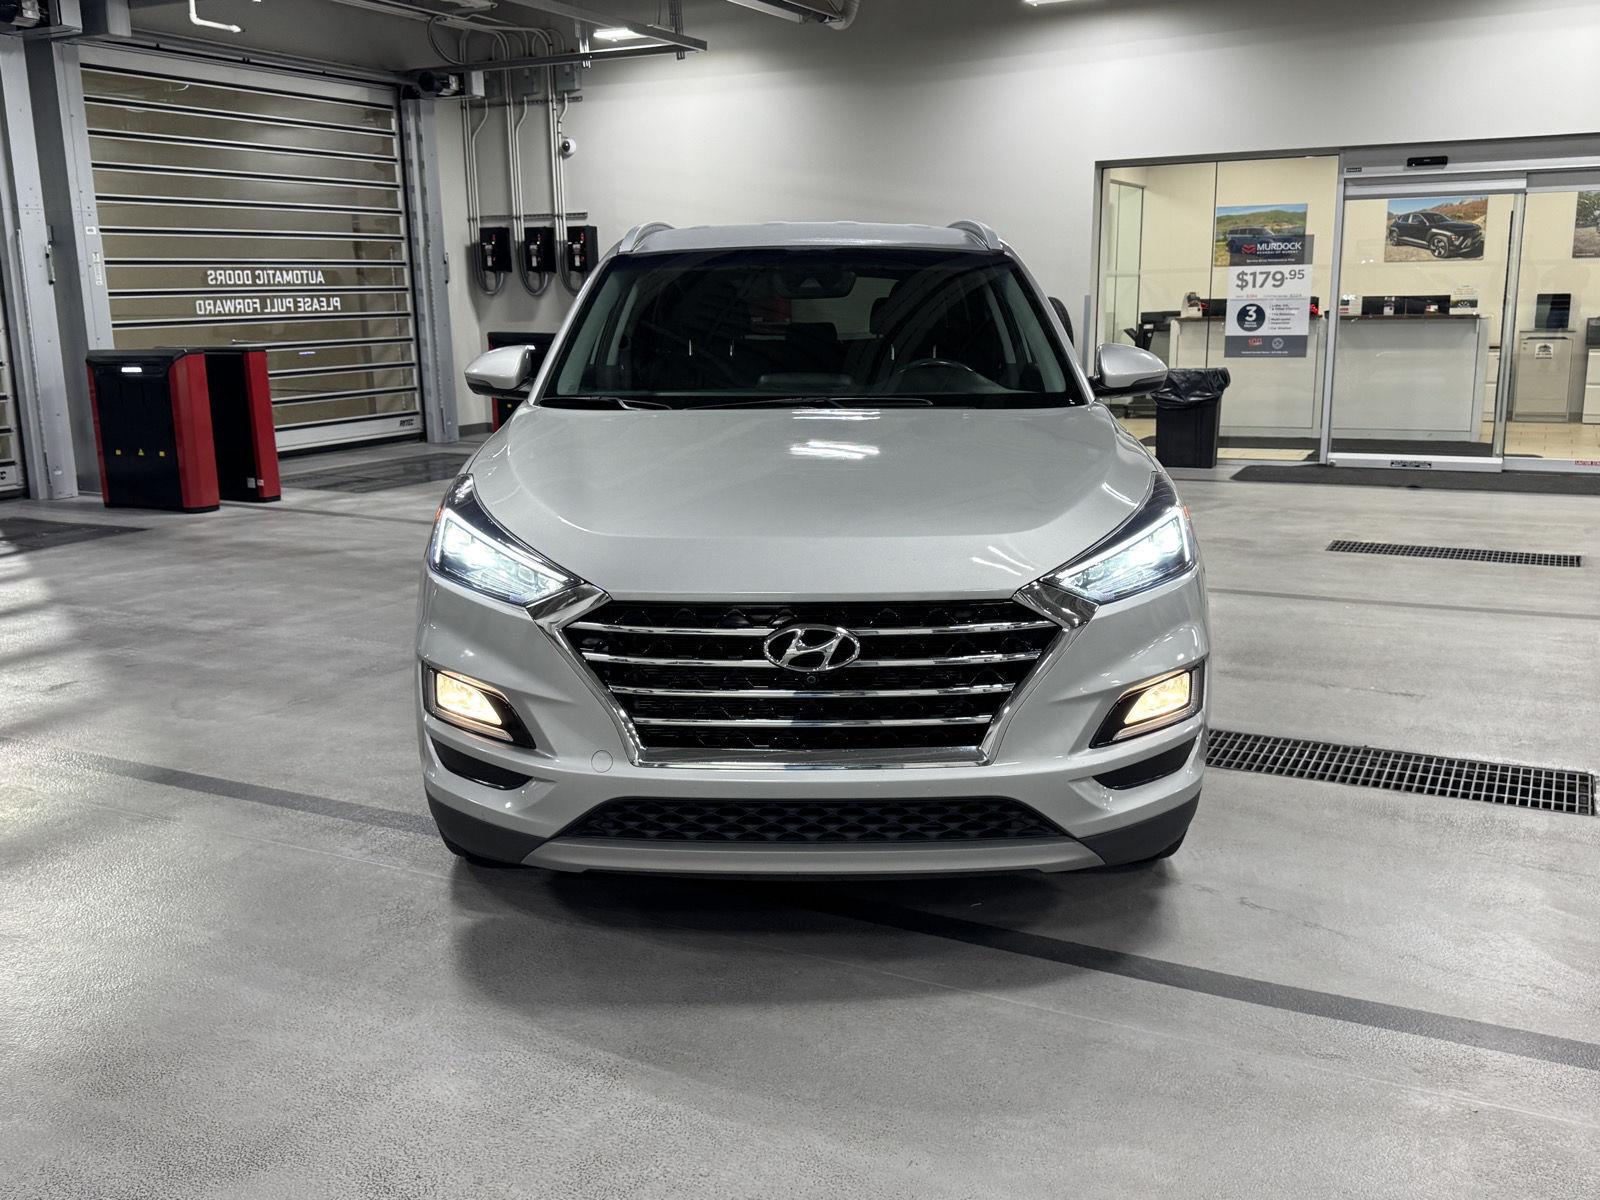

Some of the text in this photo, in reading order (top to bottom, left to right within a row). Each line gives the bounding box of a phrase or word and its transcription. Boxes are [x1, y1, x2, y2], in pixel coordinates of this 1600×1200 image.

[1257, 242, 1302, 250] MURDOCK
[1236, 269, 1305, 291] $179.95
[1245, 306, 1257, 321] 3
